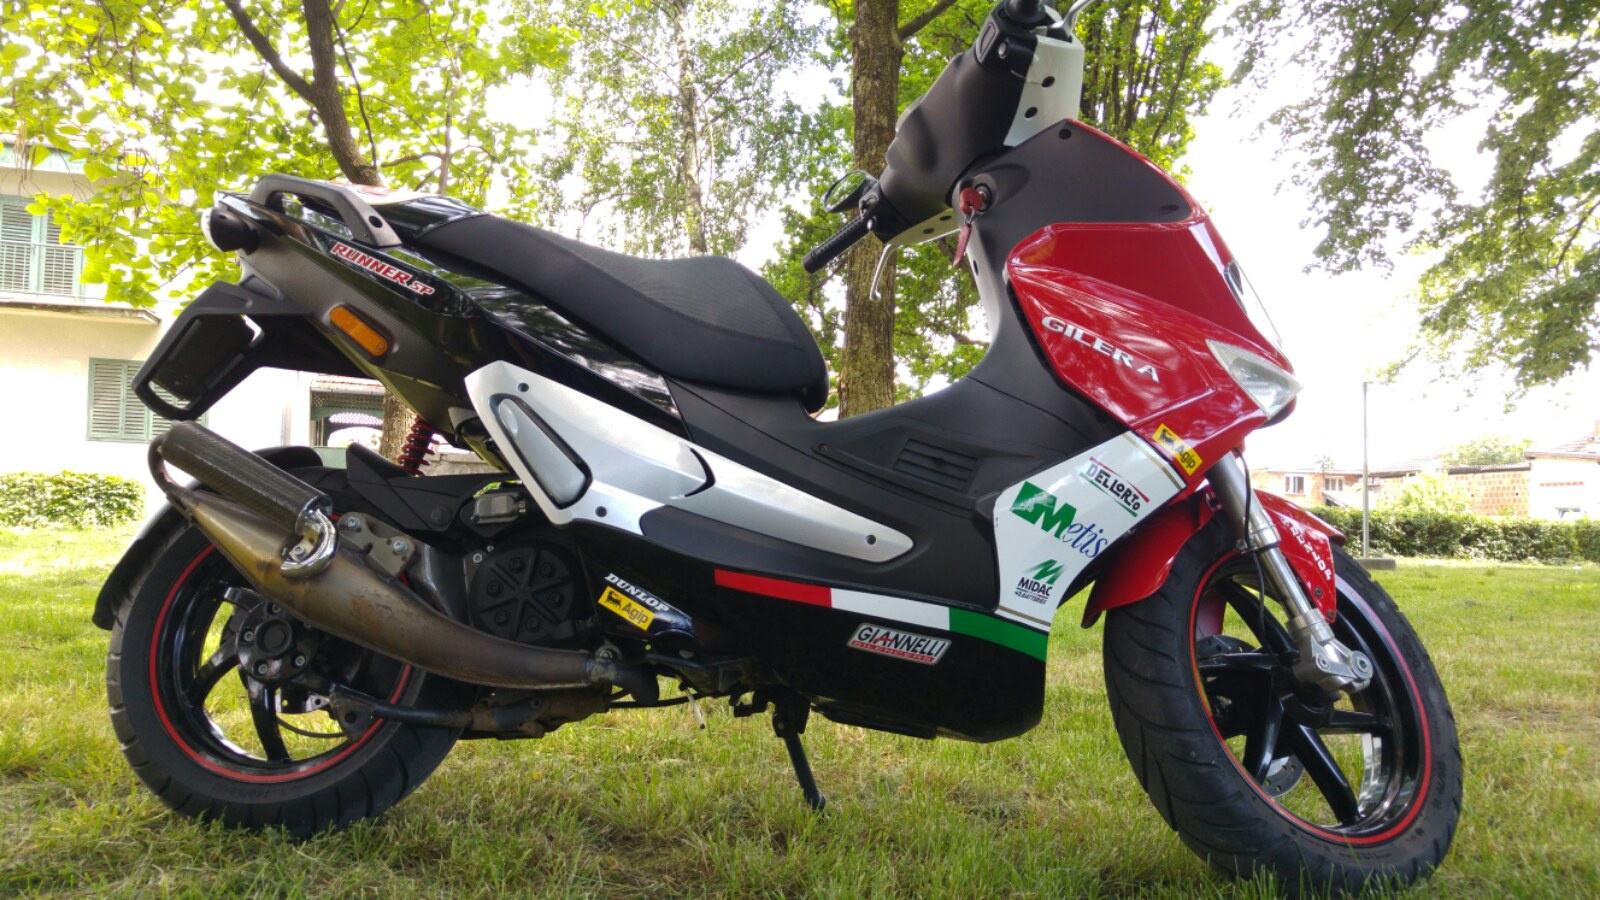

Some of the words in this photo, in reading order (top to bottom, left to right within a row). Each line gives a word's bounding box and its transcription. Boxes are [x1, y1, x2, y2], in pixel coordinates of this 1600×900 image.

[329, 242, 413, 286] RUNNER
[411, 281, 435, 295] SP
[1041, 316, 1160, 384] GILERA
[1010, 481, 1108, 559] Metis
[604, 573, 670, 612] DUNLOP
[1018, 577, 1053, 597] MIDAC
[622, 602, 649, 624] Agip
[857, 626, 946, 657] GIANNELLI
